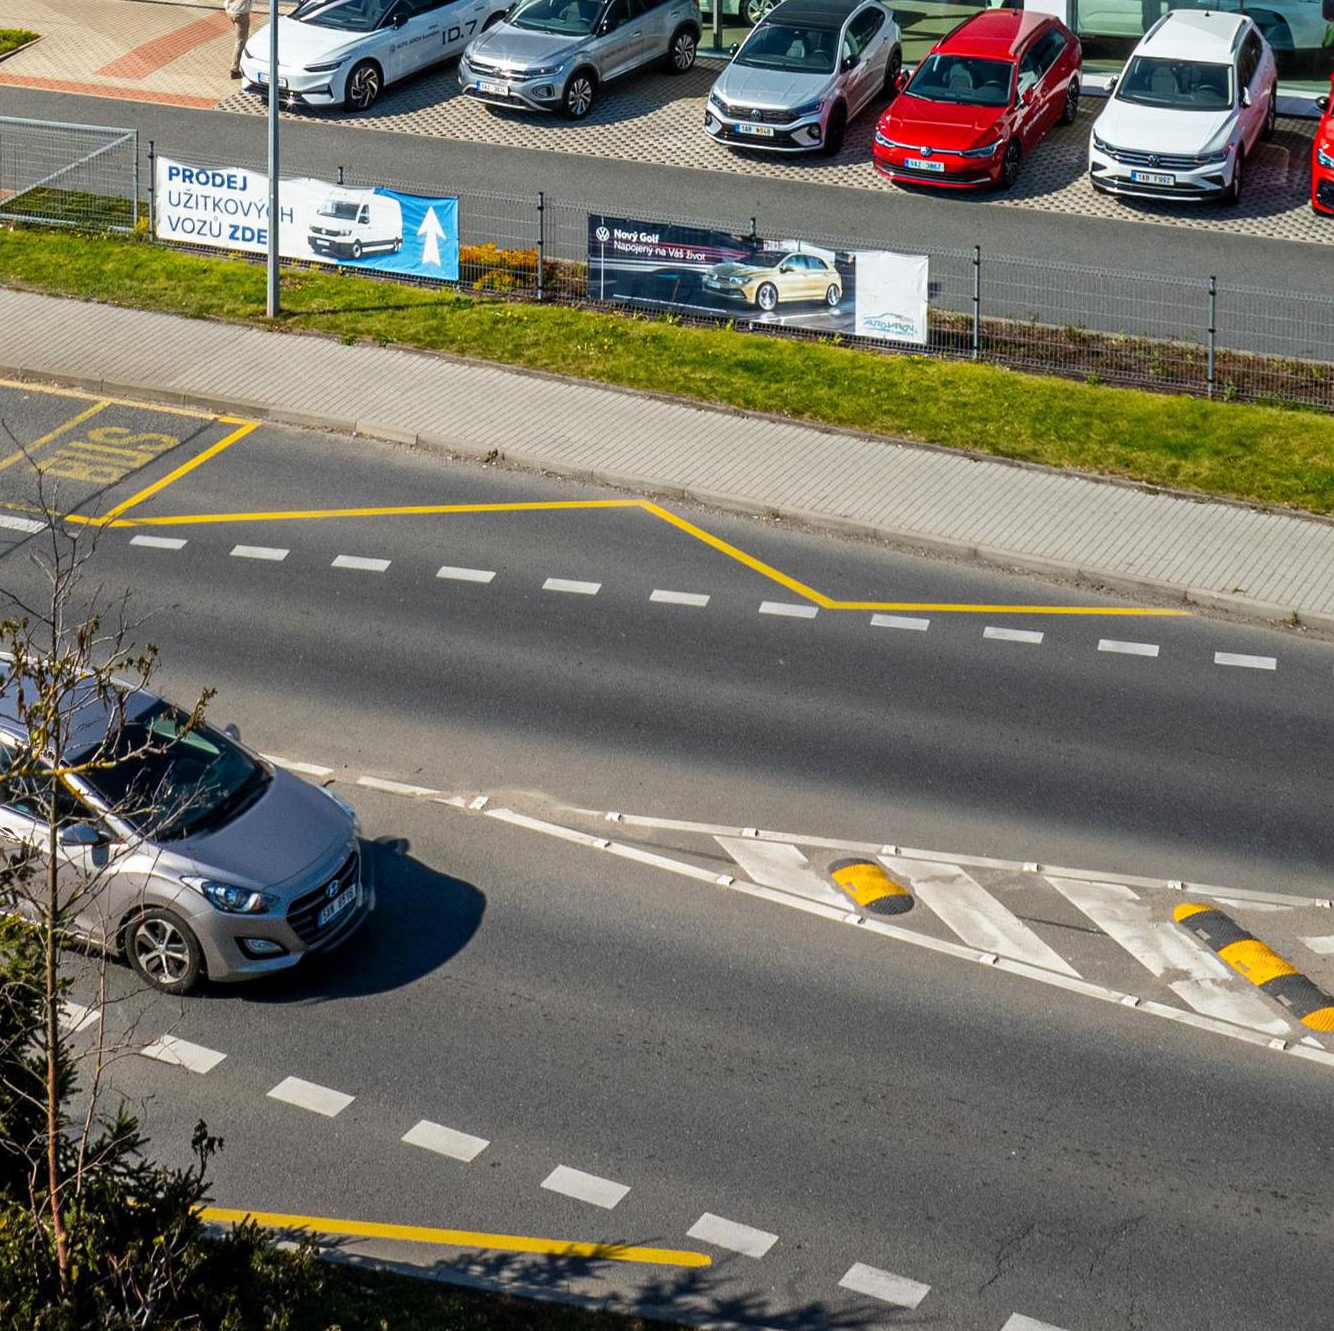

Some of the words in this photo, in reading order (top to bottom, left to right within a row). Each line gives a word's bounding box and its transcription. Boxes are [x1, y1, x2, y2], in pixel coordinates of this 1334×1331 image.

[442, 19, 478, 46] ID.7
[168, 165, 248, 192] PRODEJ
[168, 215, 222, 238] VOZŮ
[228, 224, 268, 245] ZDE
[613, 228, 638, 242] Nový
[639, 232, 660, 244] Golf
[613, 240, 653, 257] Napojený
[655, 247, 667, 257] na
